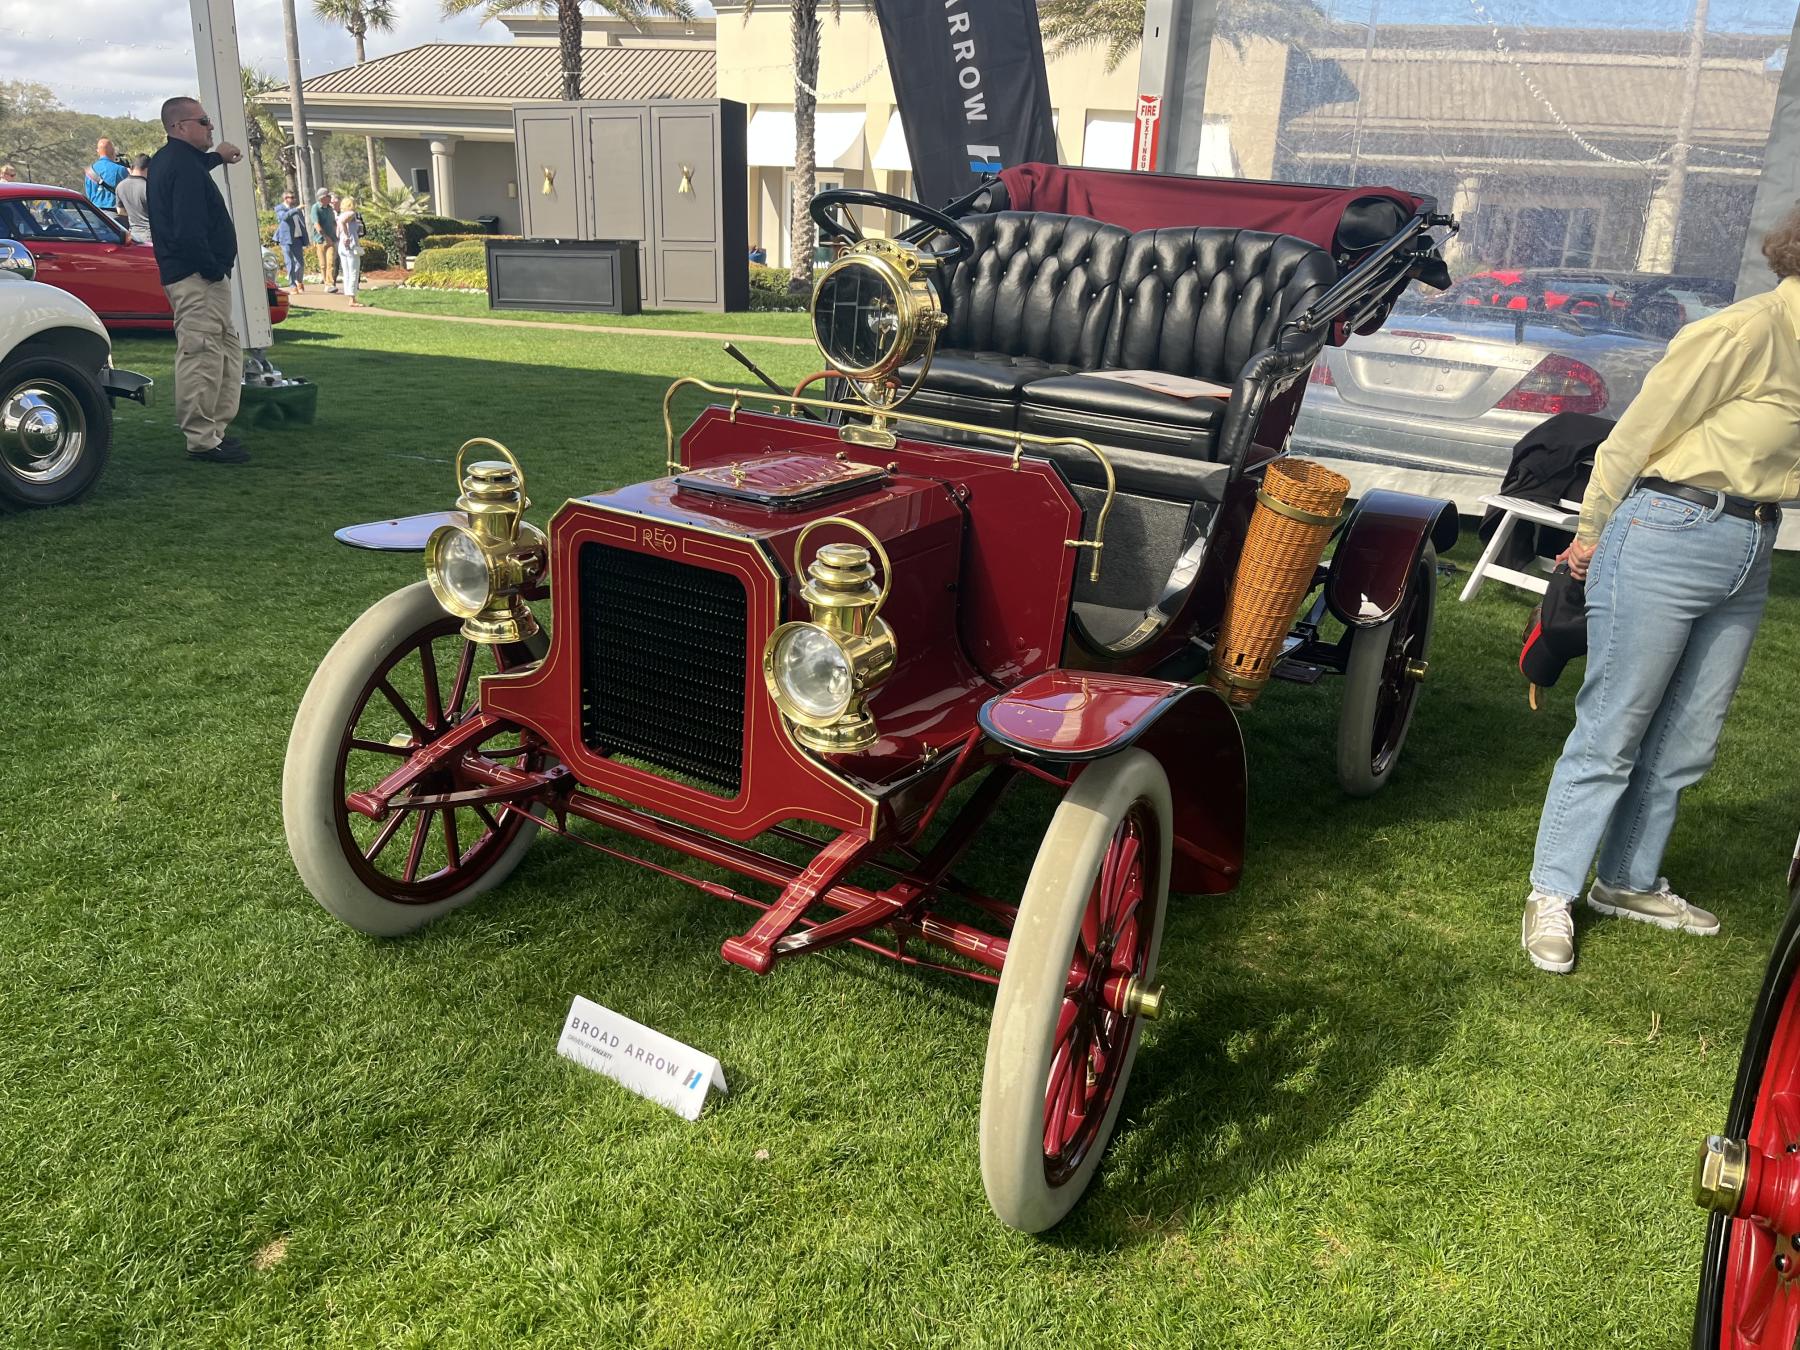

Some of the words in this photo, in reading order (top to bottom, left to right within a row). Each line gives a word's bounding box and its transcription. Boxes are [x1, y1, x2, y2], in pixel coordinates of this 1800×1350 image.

[1141, 105, 1157, 117] FIRE
[1141, 118, 1150, 172] EXTINGU
[642, 528, 677, 552] REO
[571, 1017, 620, 1048] BROAD
[624, 1043, 680, 1077] ARROW
